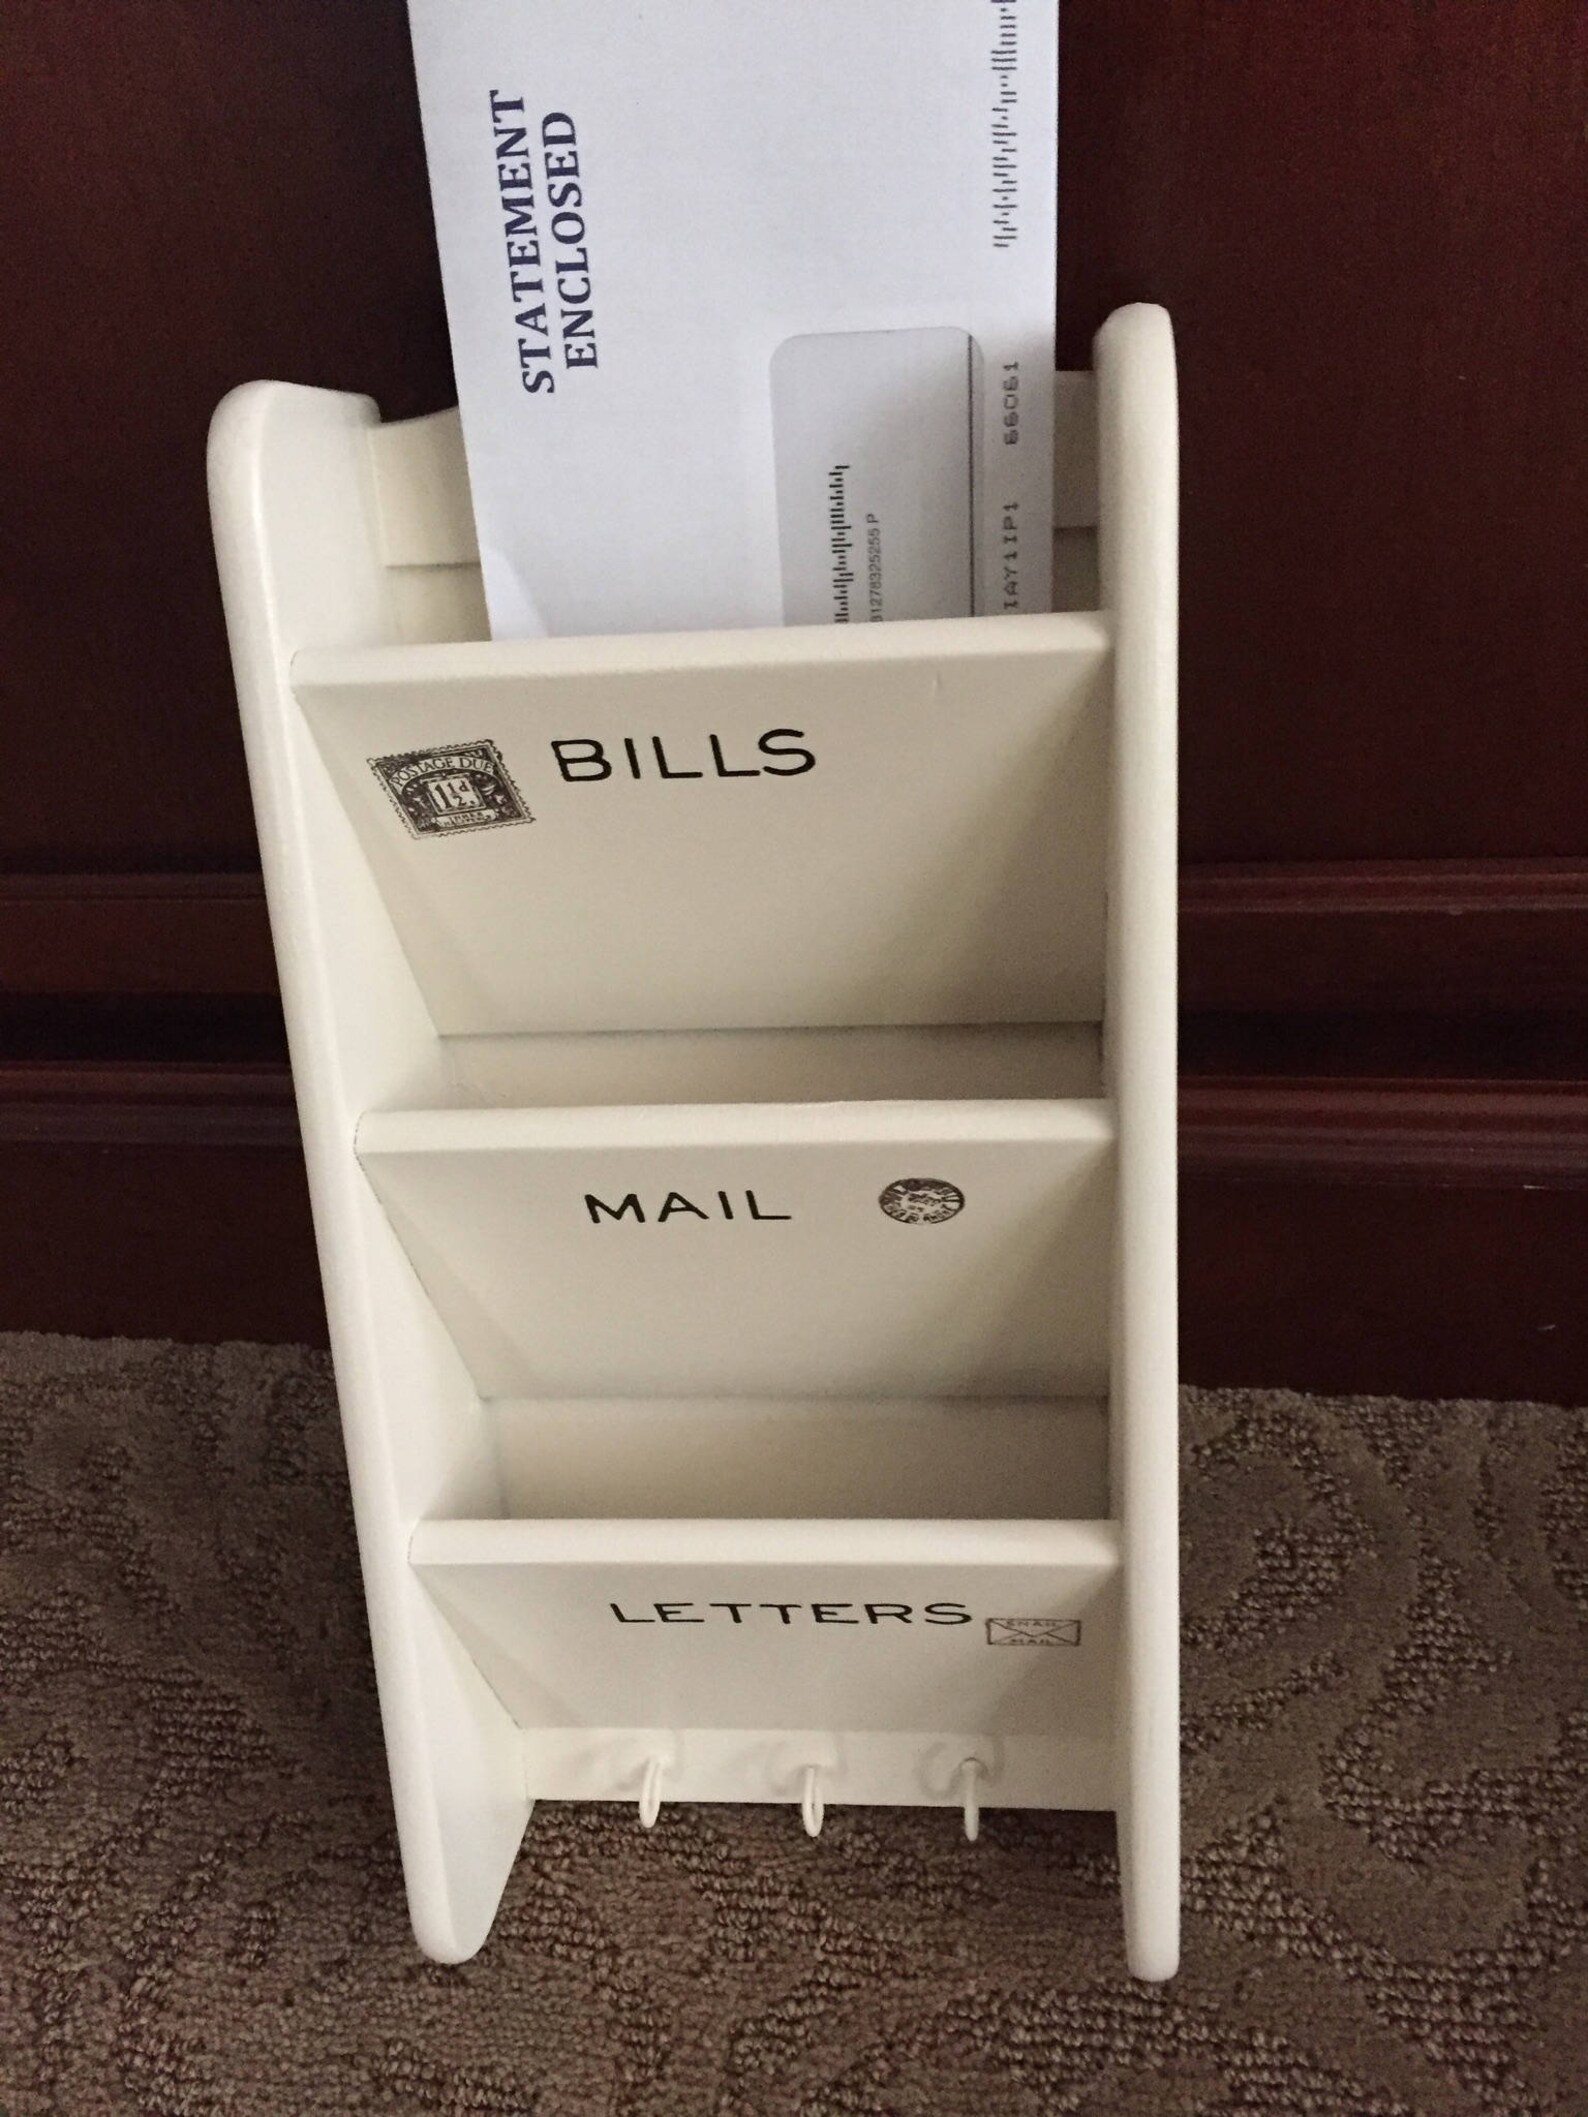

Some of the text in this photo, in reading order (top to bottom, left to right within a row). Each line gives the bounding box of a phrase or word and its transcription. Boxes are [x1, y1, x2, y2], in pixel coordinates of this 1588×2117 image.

[489, 89, 555, 394] STATEMENT
[541, 112, 598, 369] ENCLOSED
[390, 757, 495, 787] POSTAGE DUE
[551, 728, 816, 782] BILLS
[584, 1190, 792, 1224] MAIL
[610, 1602, 973, 1625] LETTERS
